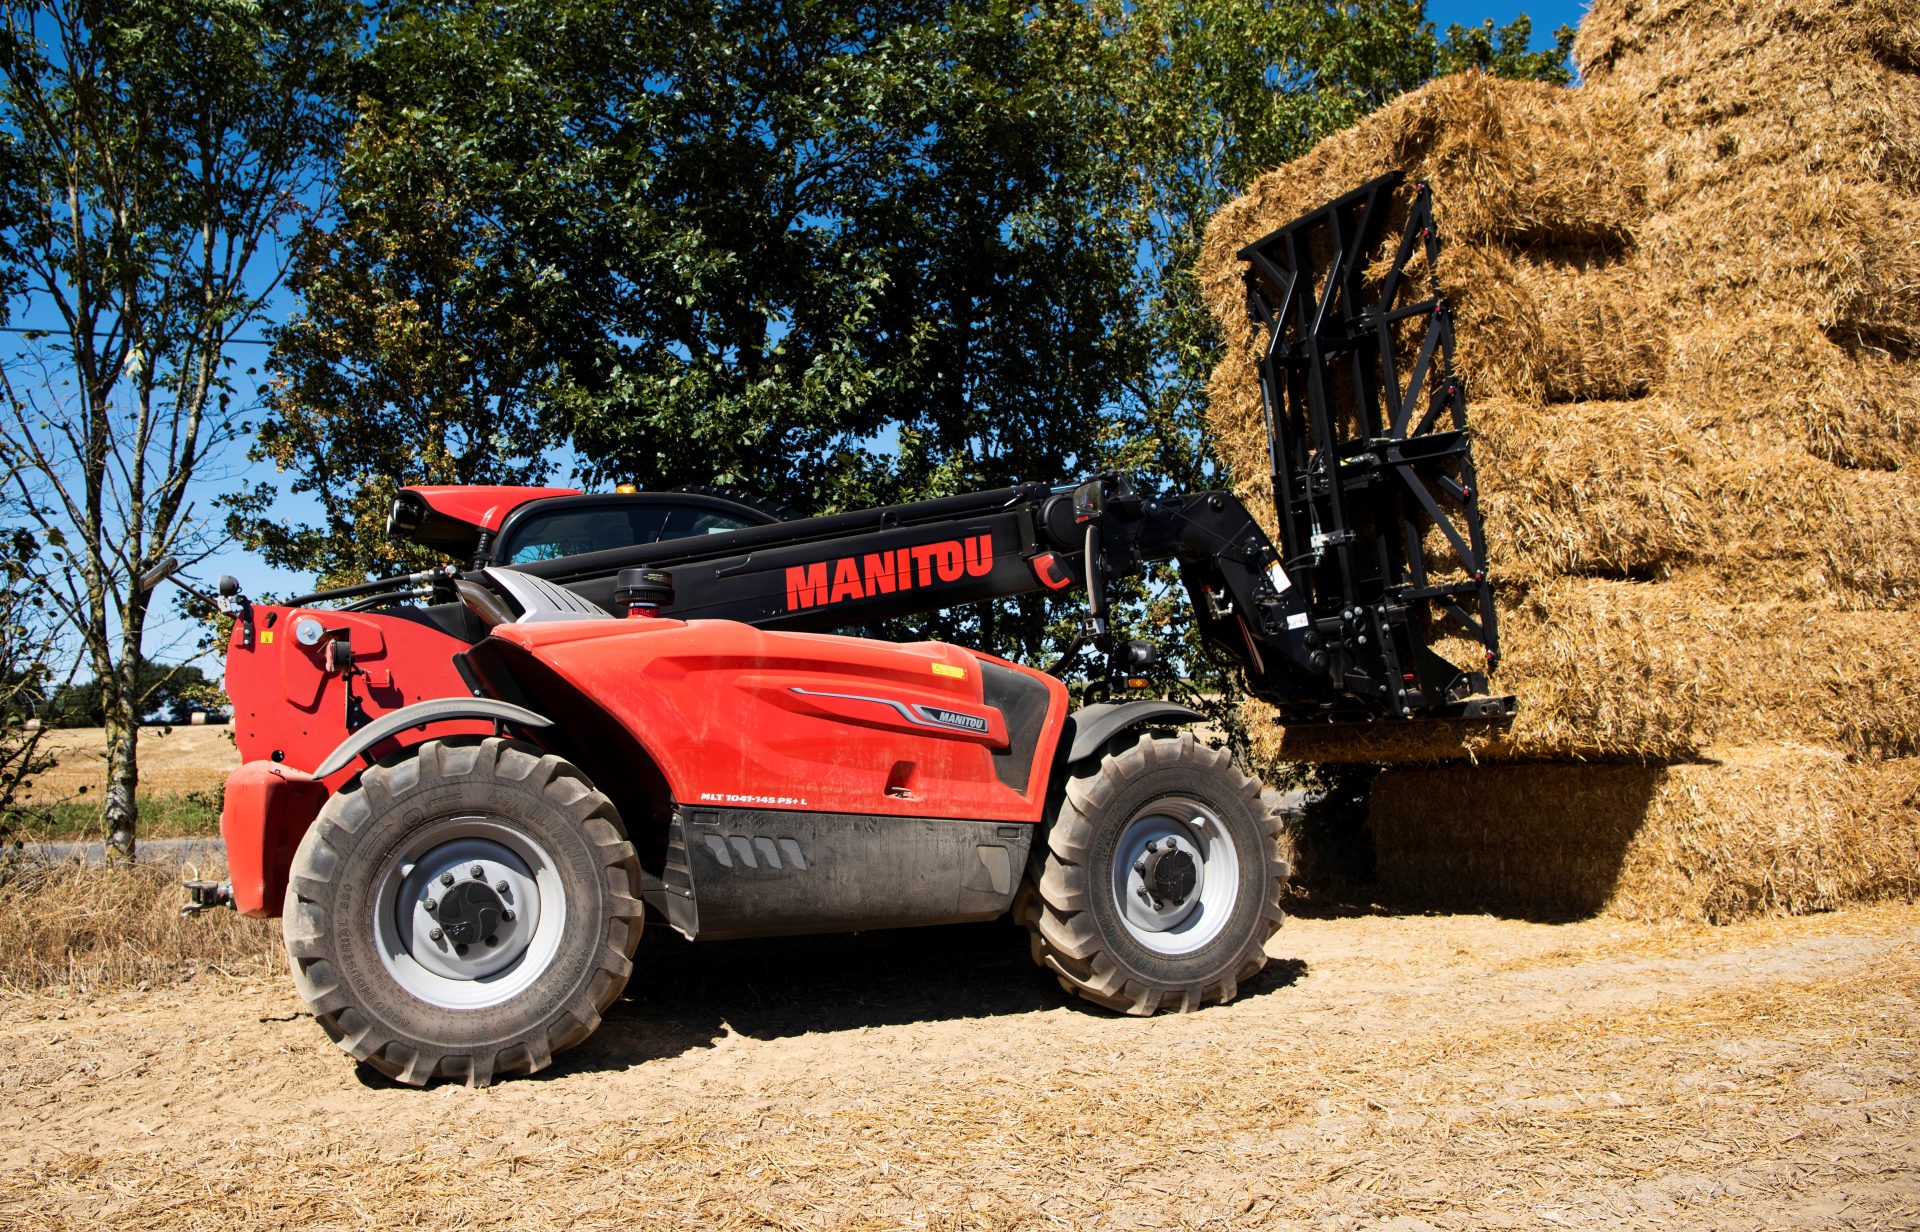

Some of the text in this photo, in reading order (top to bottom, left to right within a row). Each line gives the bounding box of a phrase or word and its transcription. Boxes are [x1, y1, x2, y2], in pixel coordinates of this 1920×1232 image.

[786, 534, 993, 611] MANITOU
[940, 711, 984, 729] MANITOU
[701, 792, 724, 801] MLT
[726, 794, 775, 804] 1041-145
[777, 797, 799, 805] PS+
[503, 795, 591, 884] ALLIANCE
[338, 919, 377, 1000] INDUSTRIAL
[375, 1002, 410, 1028] AGRO
